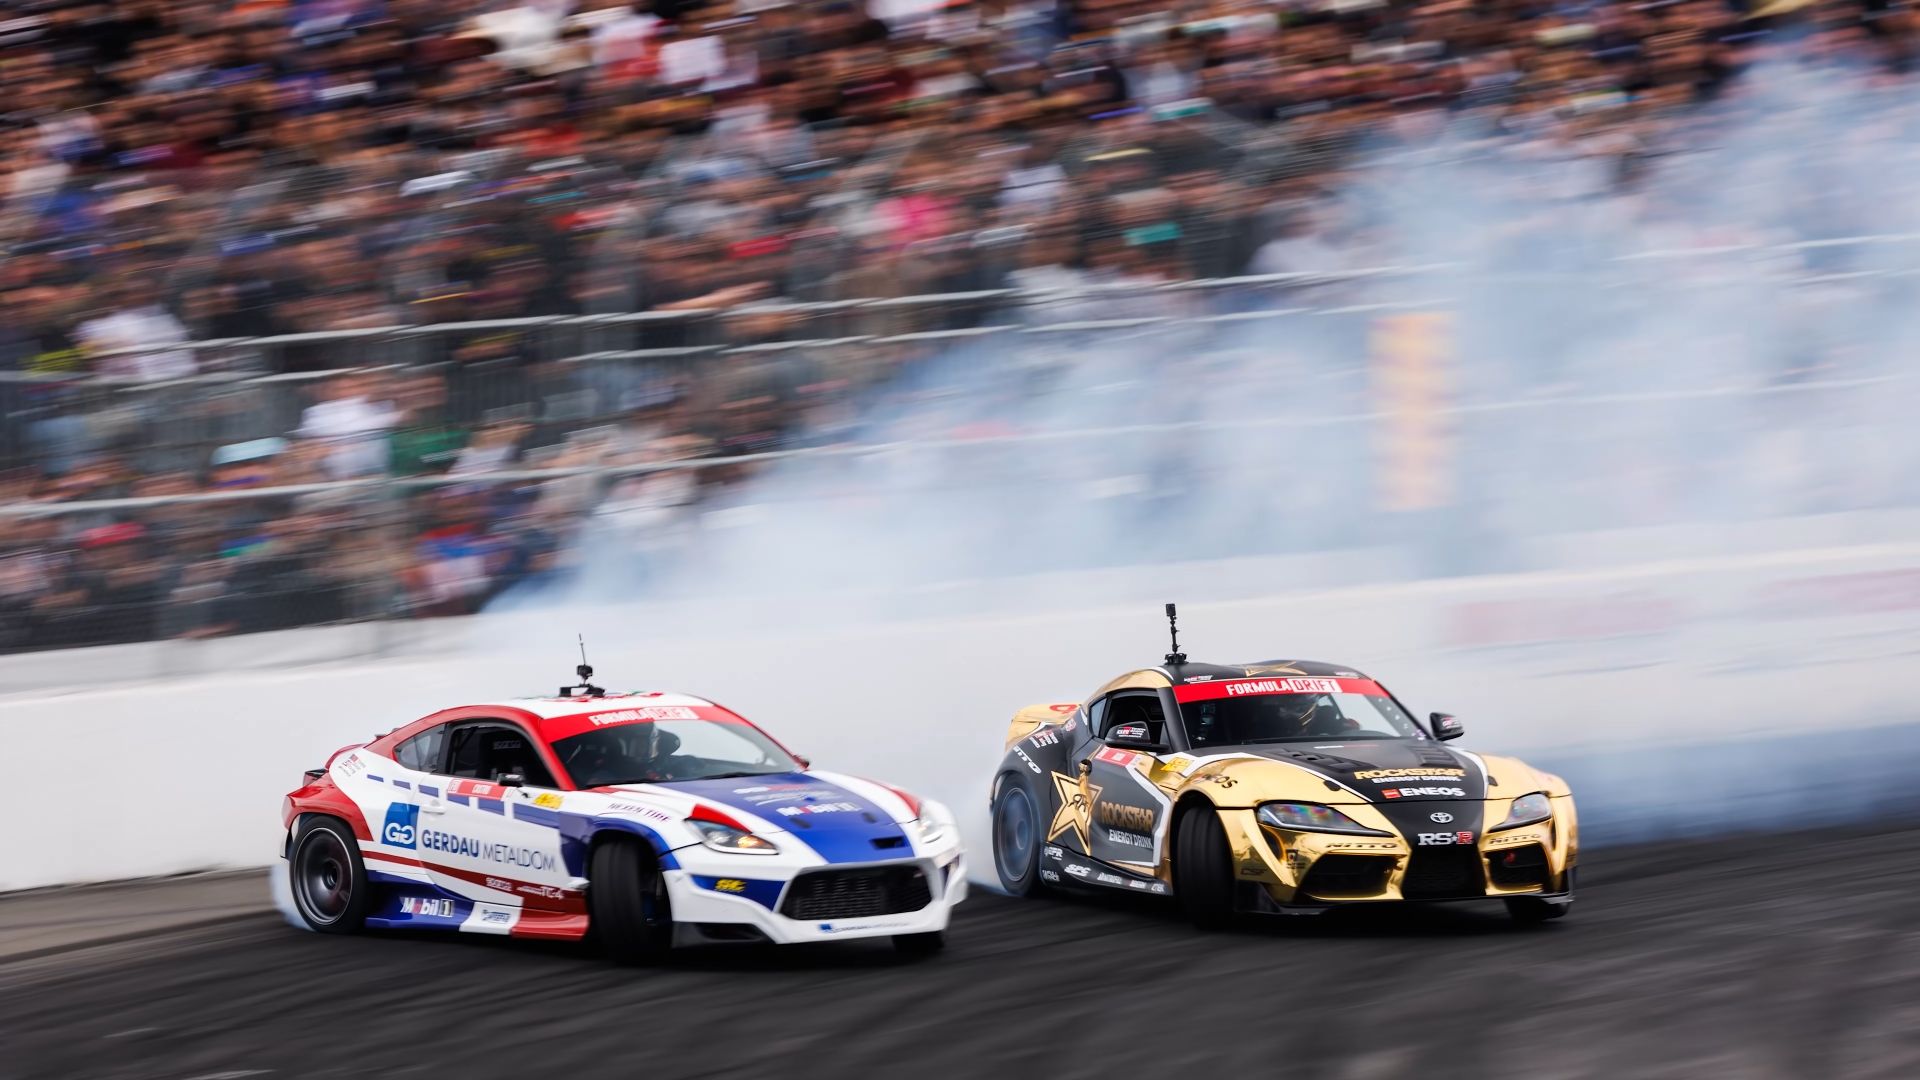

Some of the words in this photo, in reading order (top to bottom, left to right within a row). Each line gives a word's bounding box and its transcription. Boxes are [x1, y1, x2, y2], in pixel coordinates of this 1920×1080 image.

[1226, 681, 1291, 696] FORMULA
[1354, 768, 1465, 779] ROCKSTAR
[1399, 787, 1466, 796] ENEOS
[1101, 801, 1154, 832] ROCKSTAR
[1108, 829, 1133, 845] ENERGY
[1133, 834, 1153, 848] DRINK
[421, 829, 480, 858] GERDAU
[482, 844, 557, 872] METALDOM
[401, 897, 439, 916] Mobil
